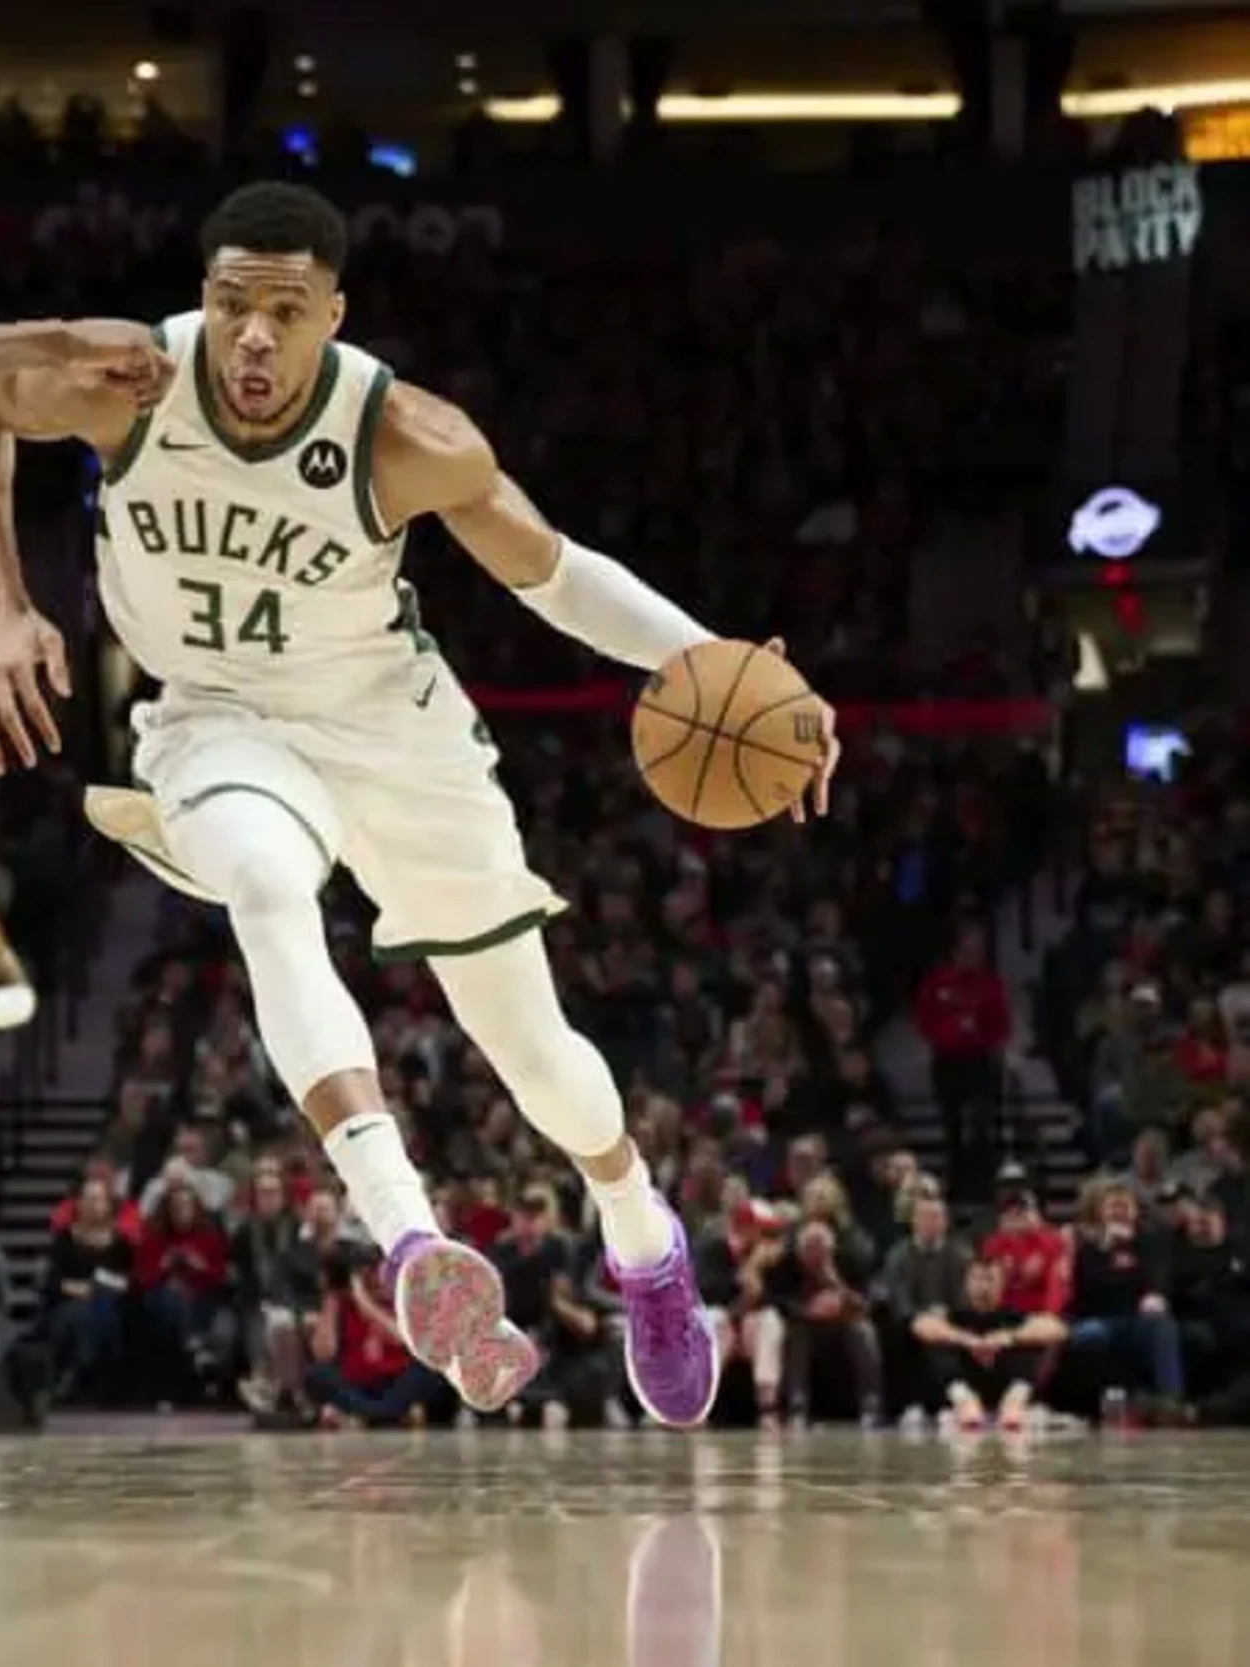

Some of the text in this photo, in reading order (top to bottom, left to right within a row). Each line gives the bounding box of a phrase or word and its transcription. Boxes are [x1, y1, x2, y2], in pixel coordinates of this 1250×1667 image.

[1071, 163, 1202, 218] BLOCK
[1071, 211, 1203, 272] PARTY
[127, 499, 351, 586] BUCKS
[178, 578, 291, 655] 34
